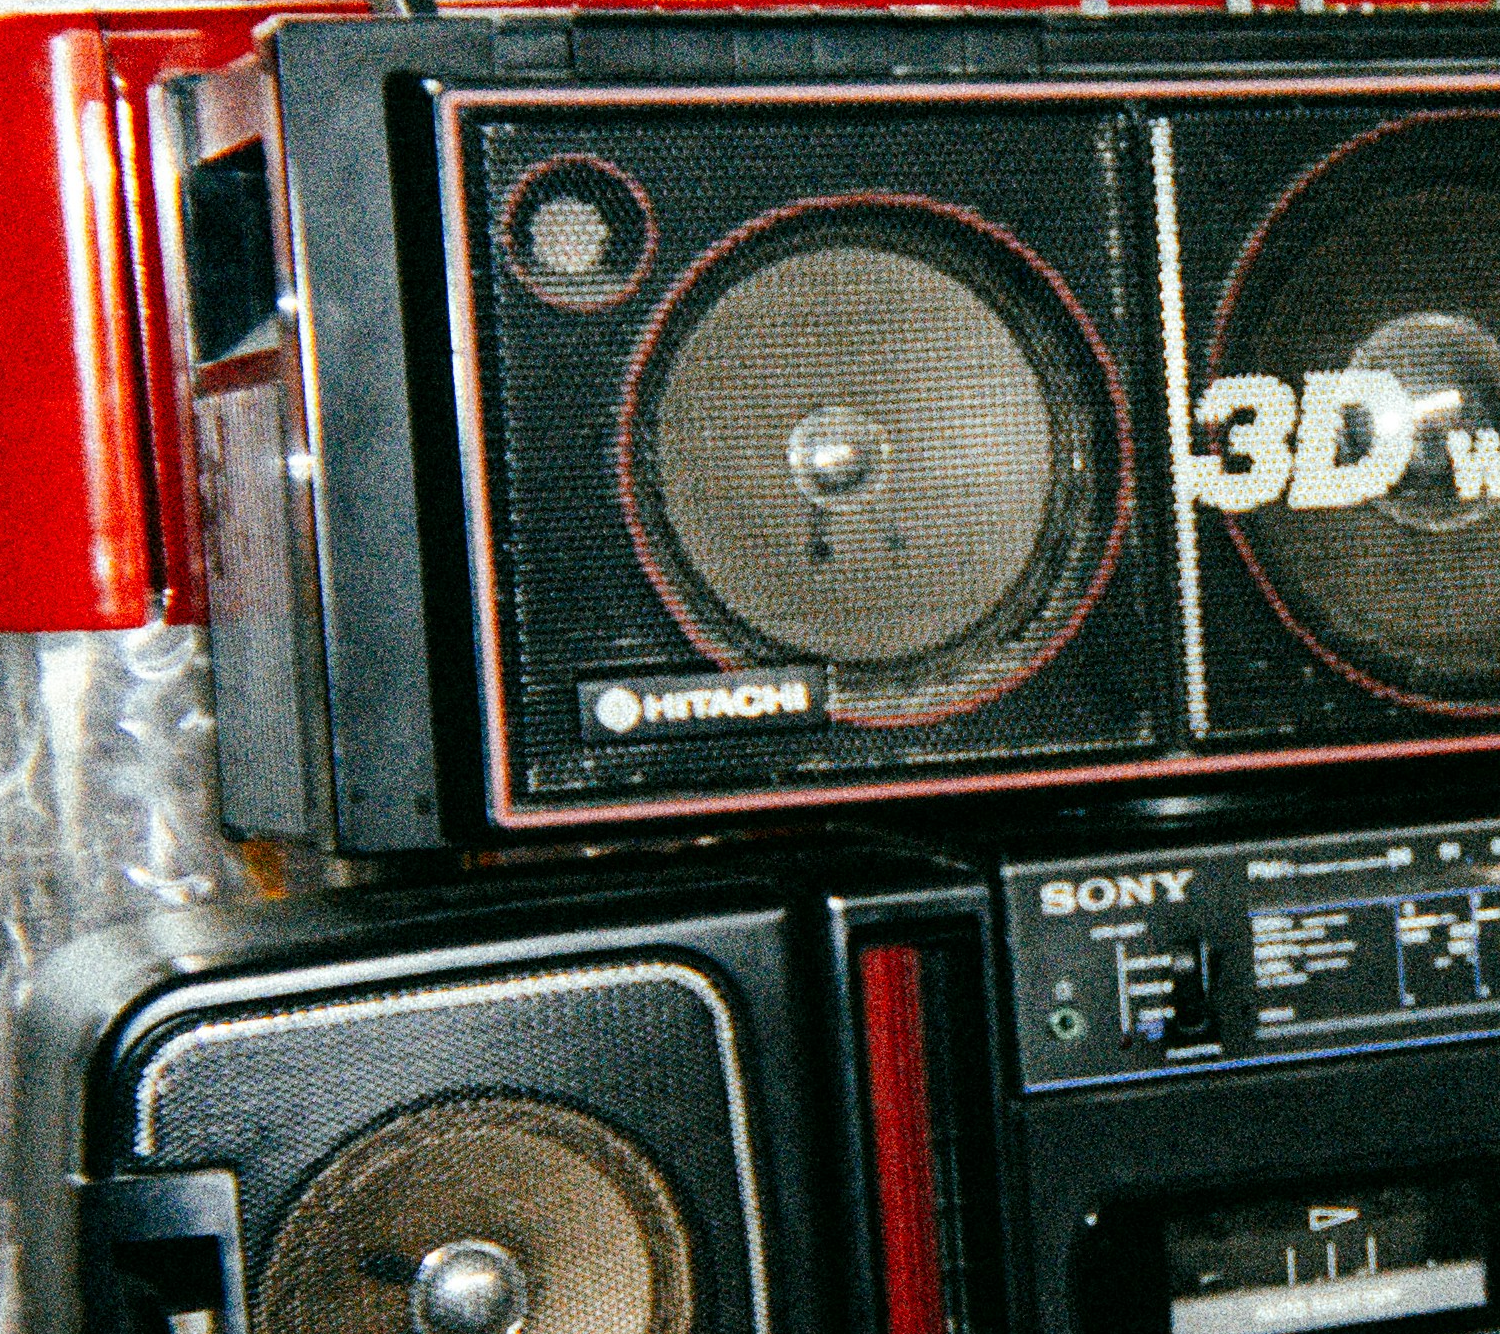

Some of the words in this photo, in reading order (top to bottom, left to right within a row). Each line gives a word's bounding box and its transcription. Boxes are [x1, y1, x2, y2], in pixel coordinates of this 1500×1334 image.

[1196, 368, 1415, 512] 3D
[643, 680, 811, 722] HITACHI
[1038, 868, 1194, 917] SONY
